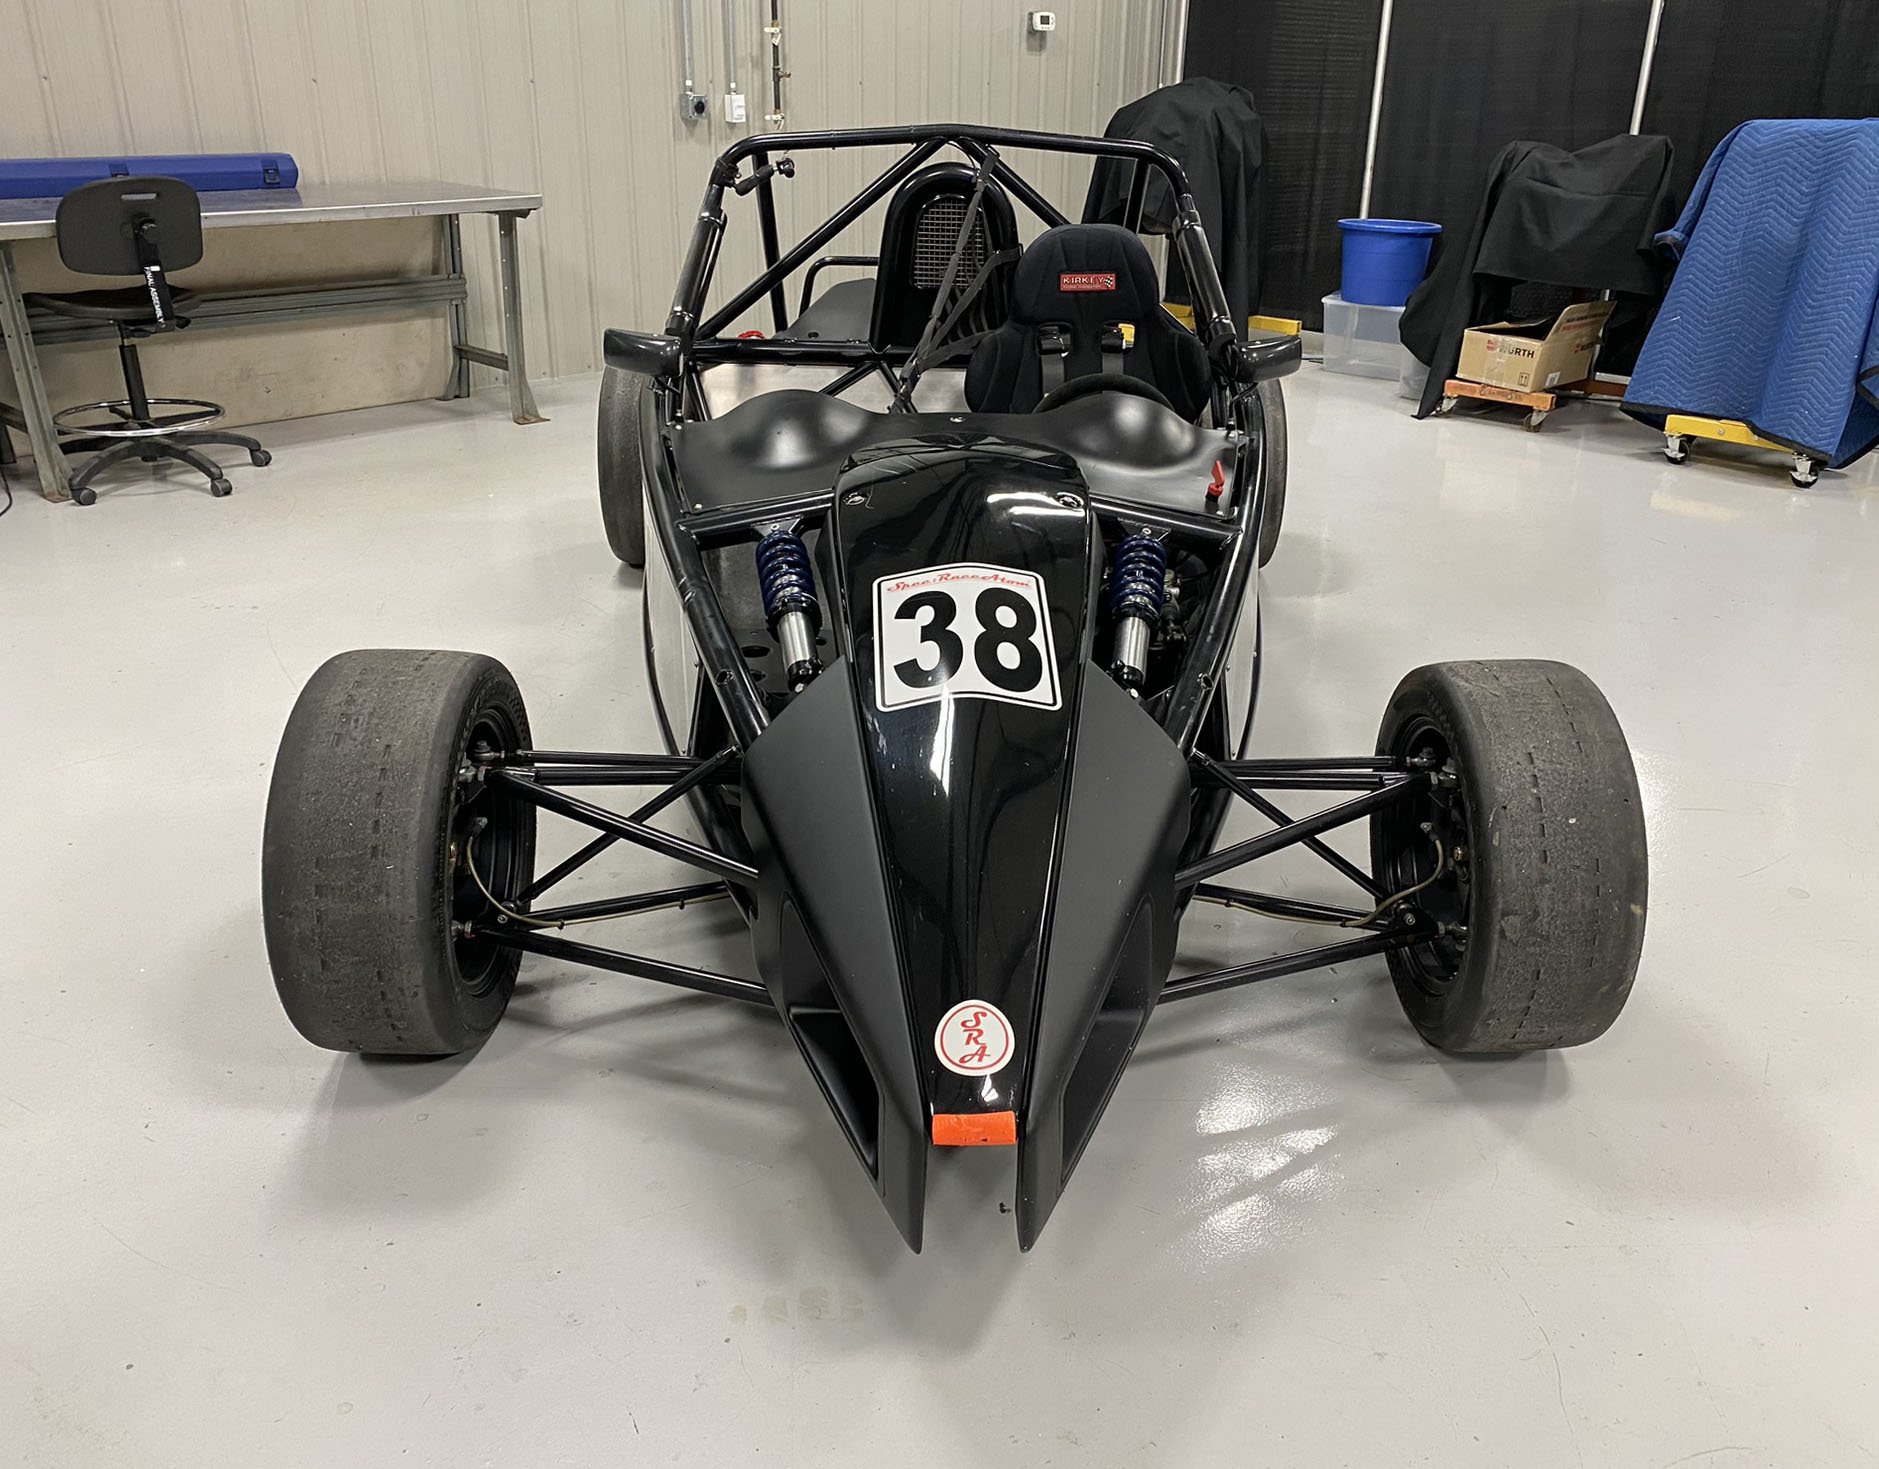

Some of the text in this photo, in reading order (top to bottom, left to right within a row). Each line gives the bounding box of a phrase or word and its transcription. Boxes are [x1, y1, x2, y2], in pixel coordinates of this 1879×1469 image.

[144, 266, 165, 323] FINAL ASSEMBLY
[1063, 276, 1104, 285] KIRKEY
[1499, 344, 1535, 359] URTH
[893, 587, 1043, 692] 38
